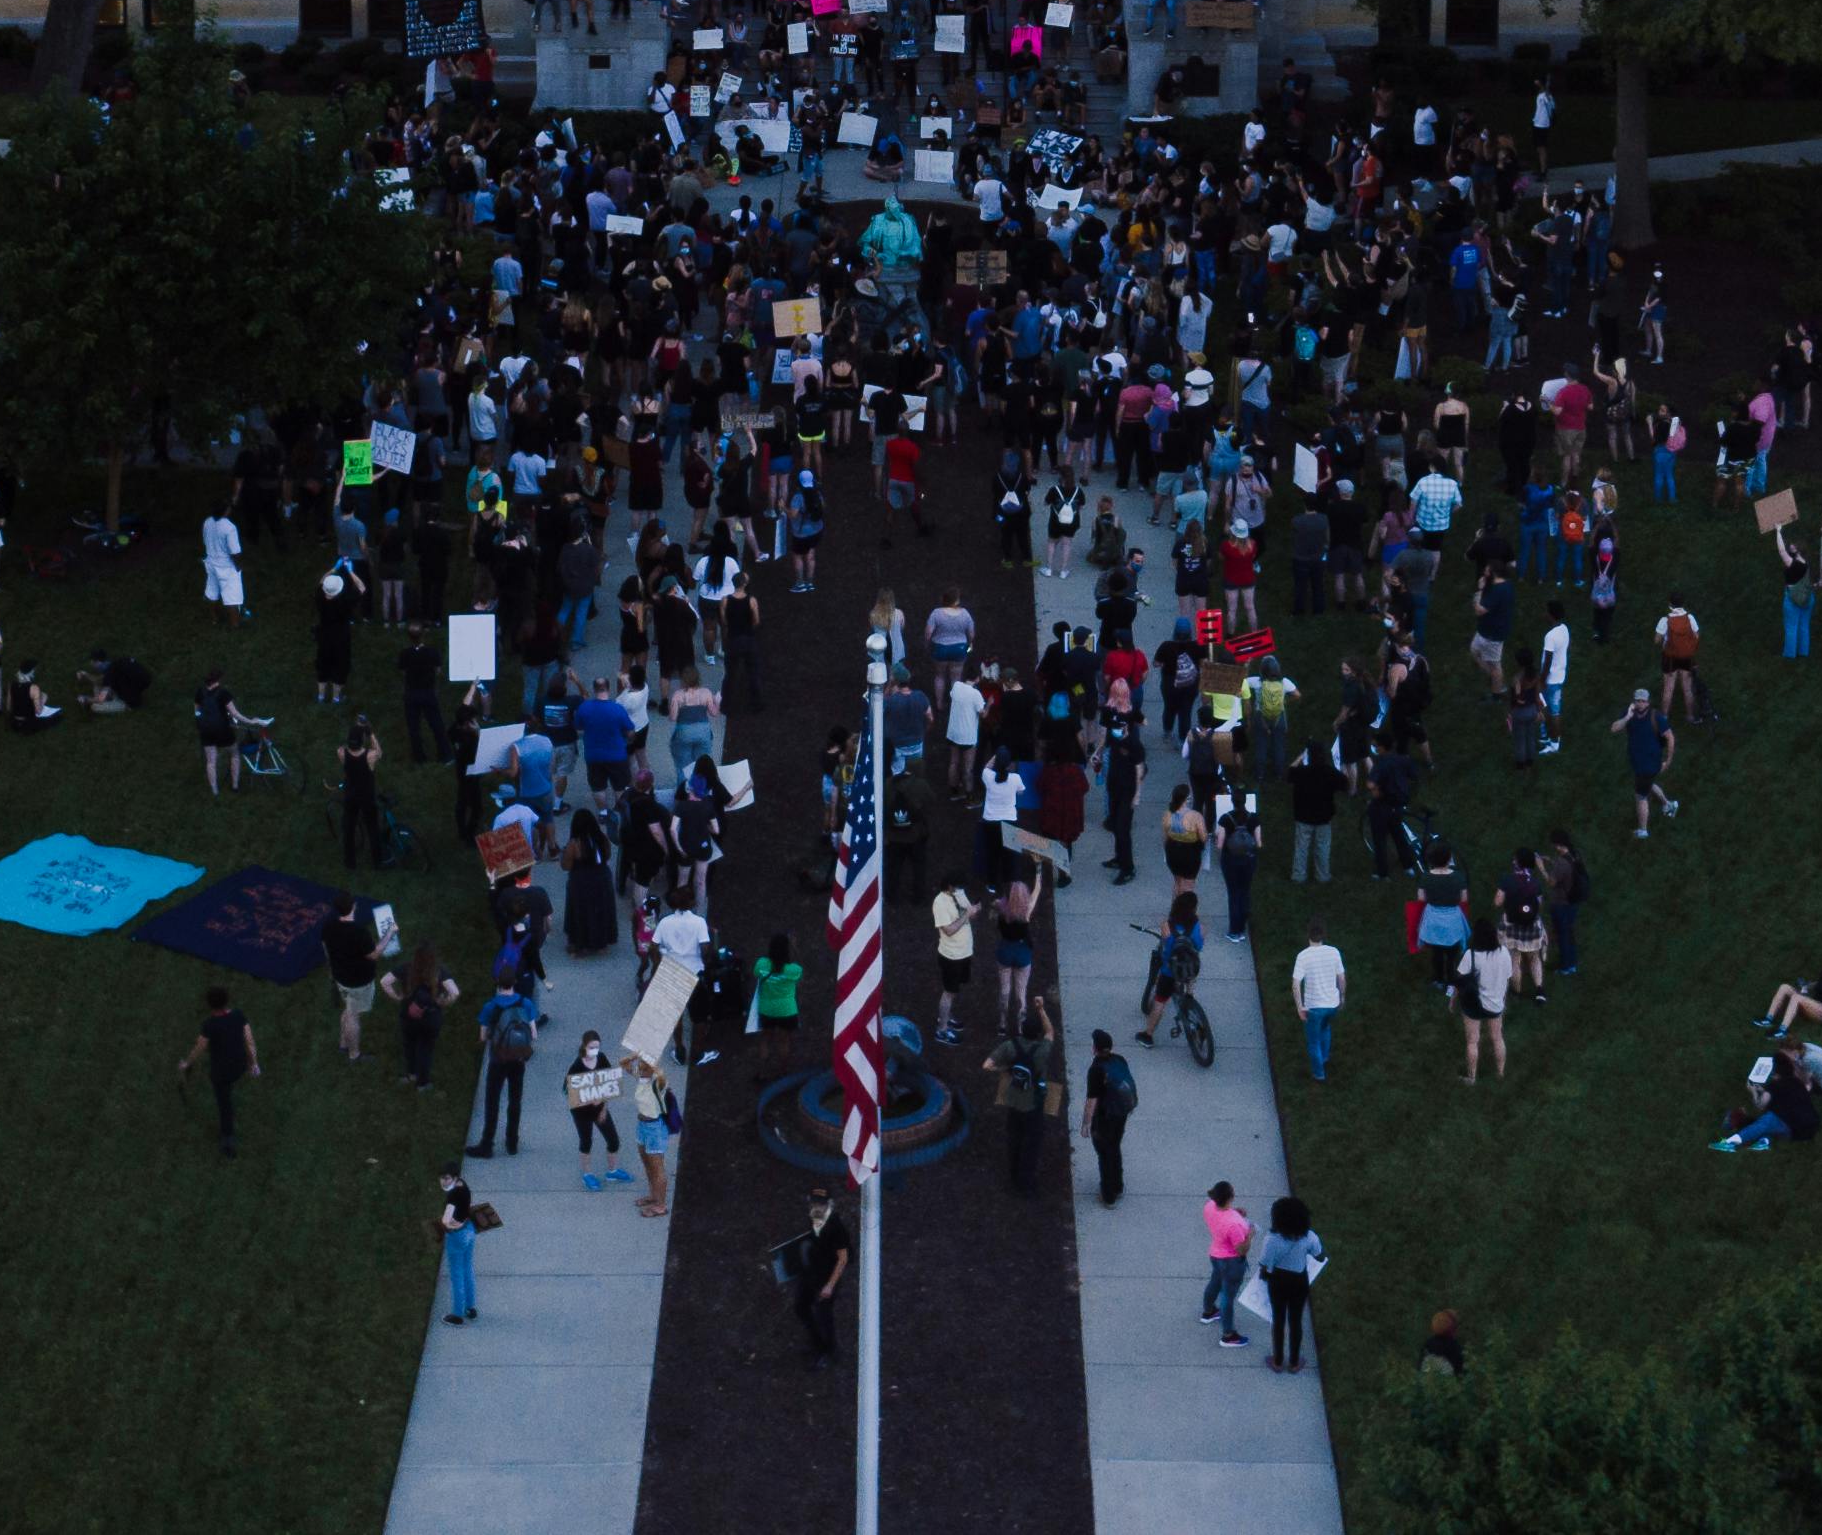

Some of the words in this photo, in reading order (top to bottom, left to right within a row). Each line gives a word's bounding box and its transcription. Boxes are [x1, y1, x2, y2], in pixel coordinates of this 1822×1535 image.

[375, 423, 411, 442] BLACK
[570, 1072, 595, 1089] SAY
[579, 1080, 621, 1103] NAMES
